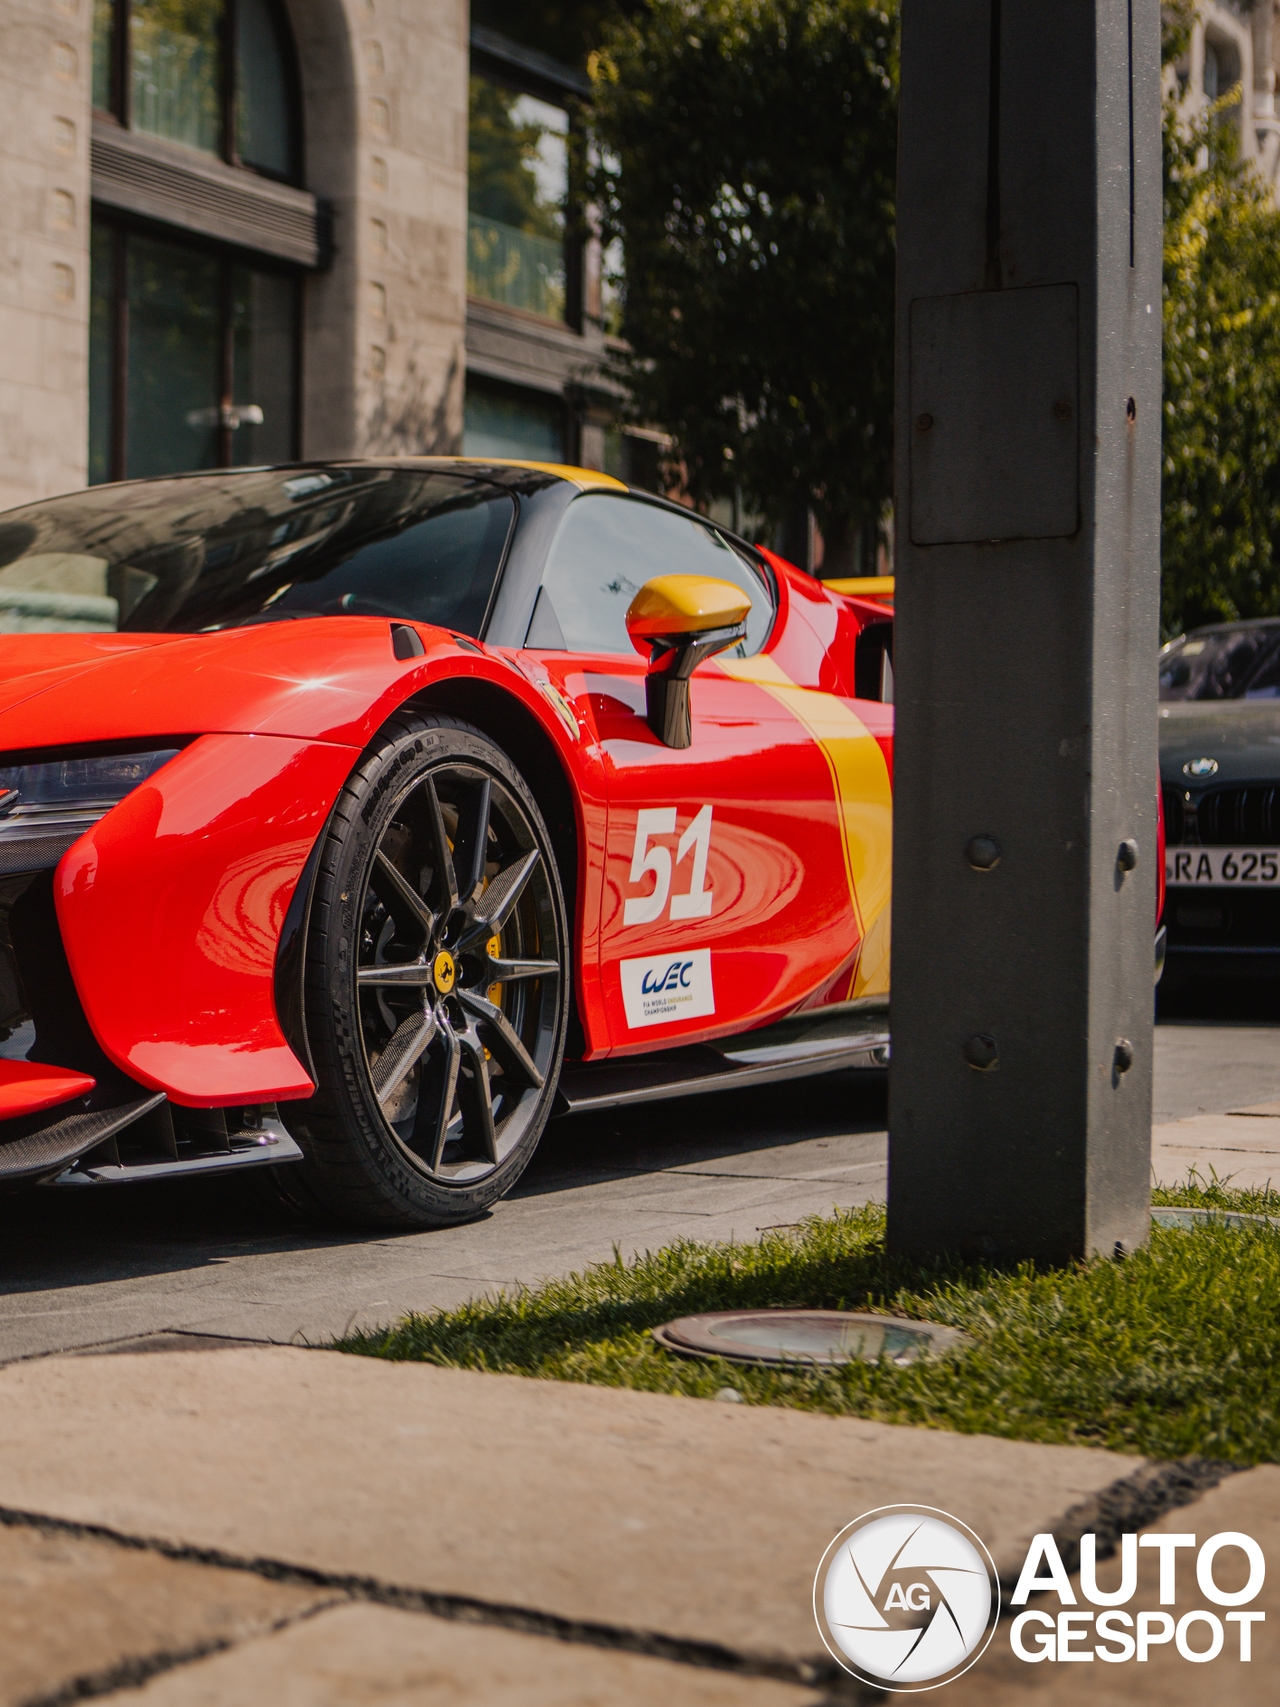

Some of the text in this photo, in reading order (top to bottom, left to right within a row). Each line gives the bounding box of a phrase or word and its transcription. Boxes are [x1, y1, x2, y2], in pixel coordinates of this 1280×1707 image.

[623, 804, 713, 926] 51
[1175, 852, 1278, 881] RA 625
[642, 961, 693, 994] WEC
[644, 1005, 677, 1016] CHAMPIONSHIP
[651, 998, 667, 1007] WORLD
[667, 994, 693, 1004] ENDURANCE
[341, 1055, 380, 1150] MICHELIN
